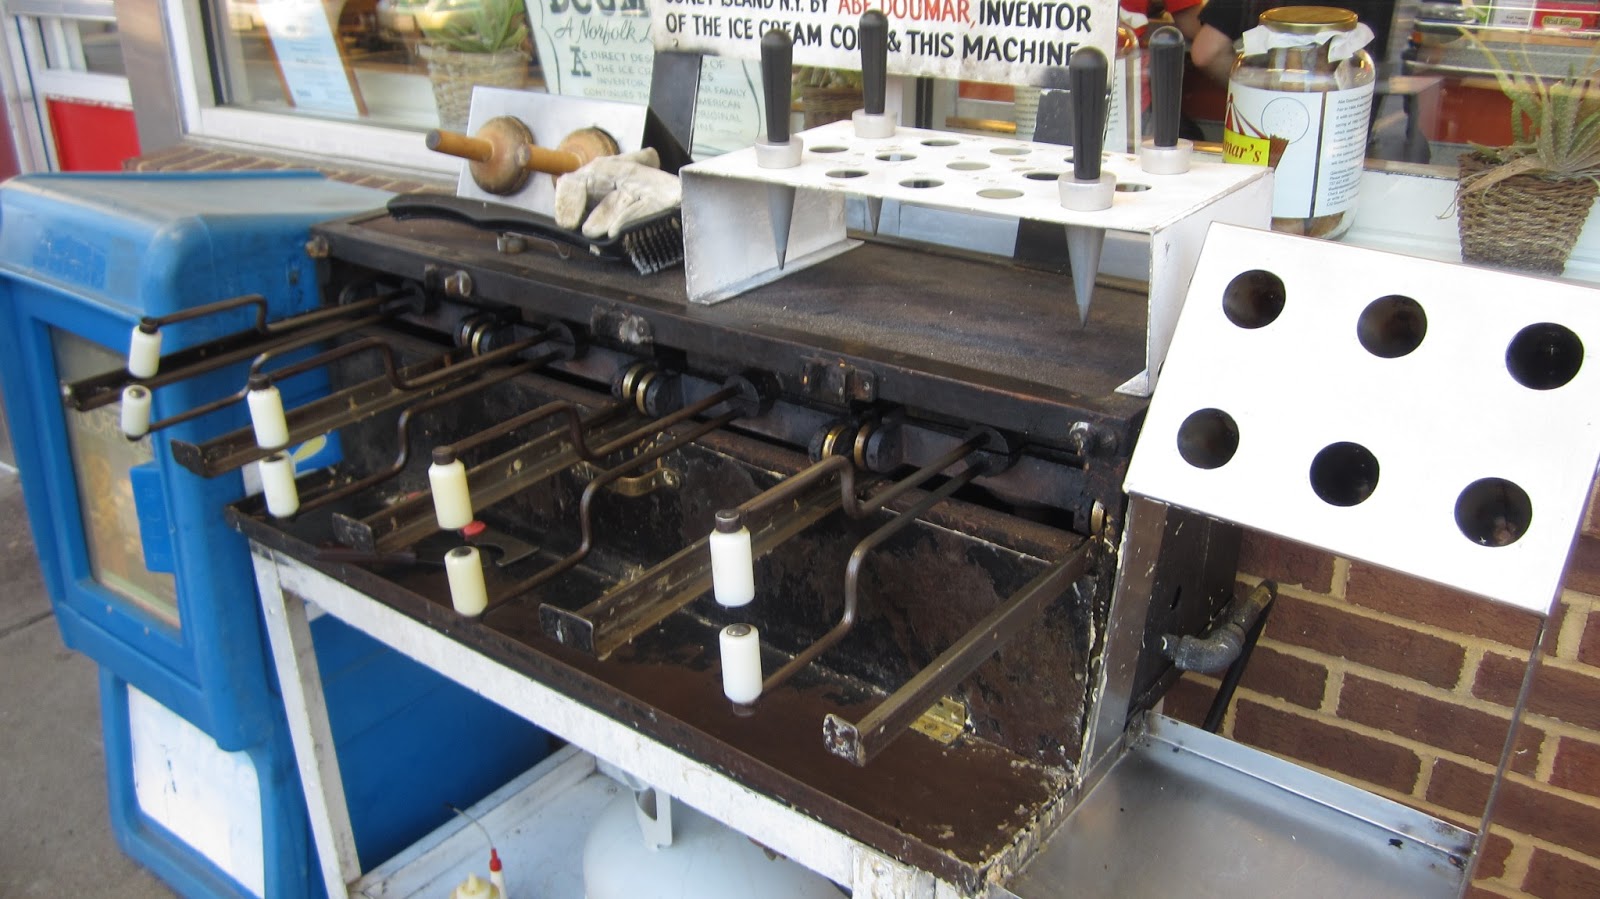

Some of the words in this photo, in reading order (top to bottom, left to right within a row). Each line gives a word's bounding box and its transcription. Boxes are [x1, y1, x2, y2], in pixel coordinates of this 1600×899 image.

[880, 0, 976, 29] DOUMAR,
[979, 0, 1092, 33] INVENTOR
[554, 17, 574, 39] A
[576, 17, 639, 45] Norfolk
[665, 12, 687, 34] OF
[693, 15, 722, 37] THE
[728, 18, 754, 40] ICE
[887, 29, 902, 53] &
[906, 29, 955, 58] THIS
[591, 51, 626, 61] DIRECT
[597, 63, 615, 73] THE
[619, 66, 634, 74] ICE
[714, 85, 747, 98] FAMILY
